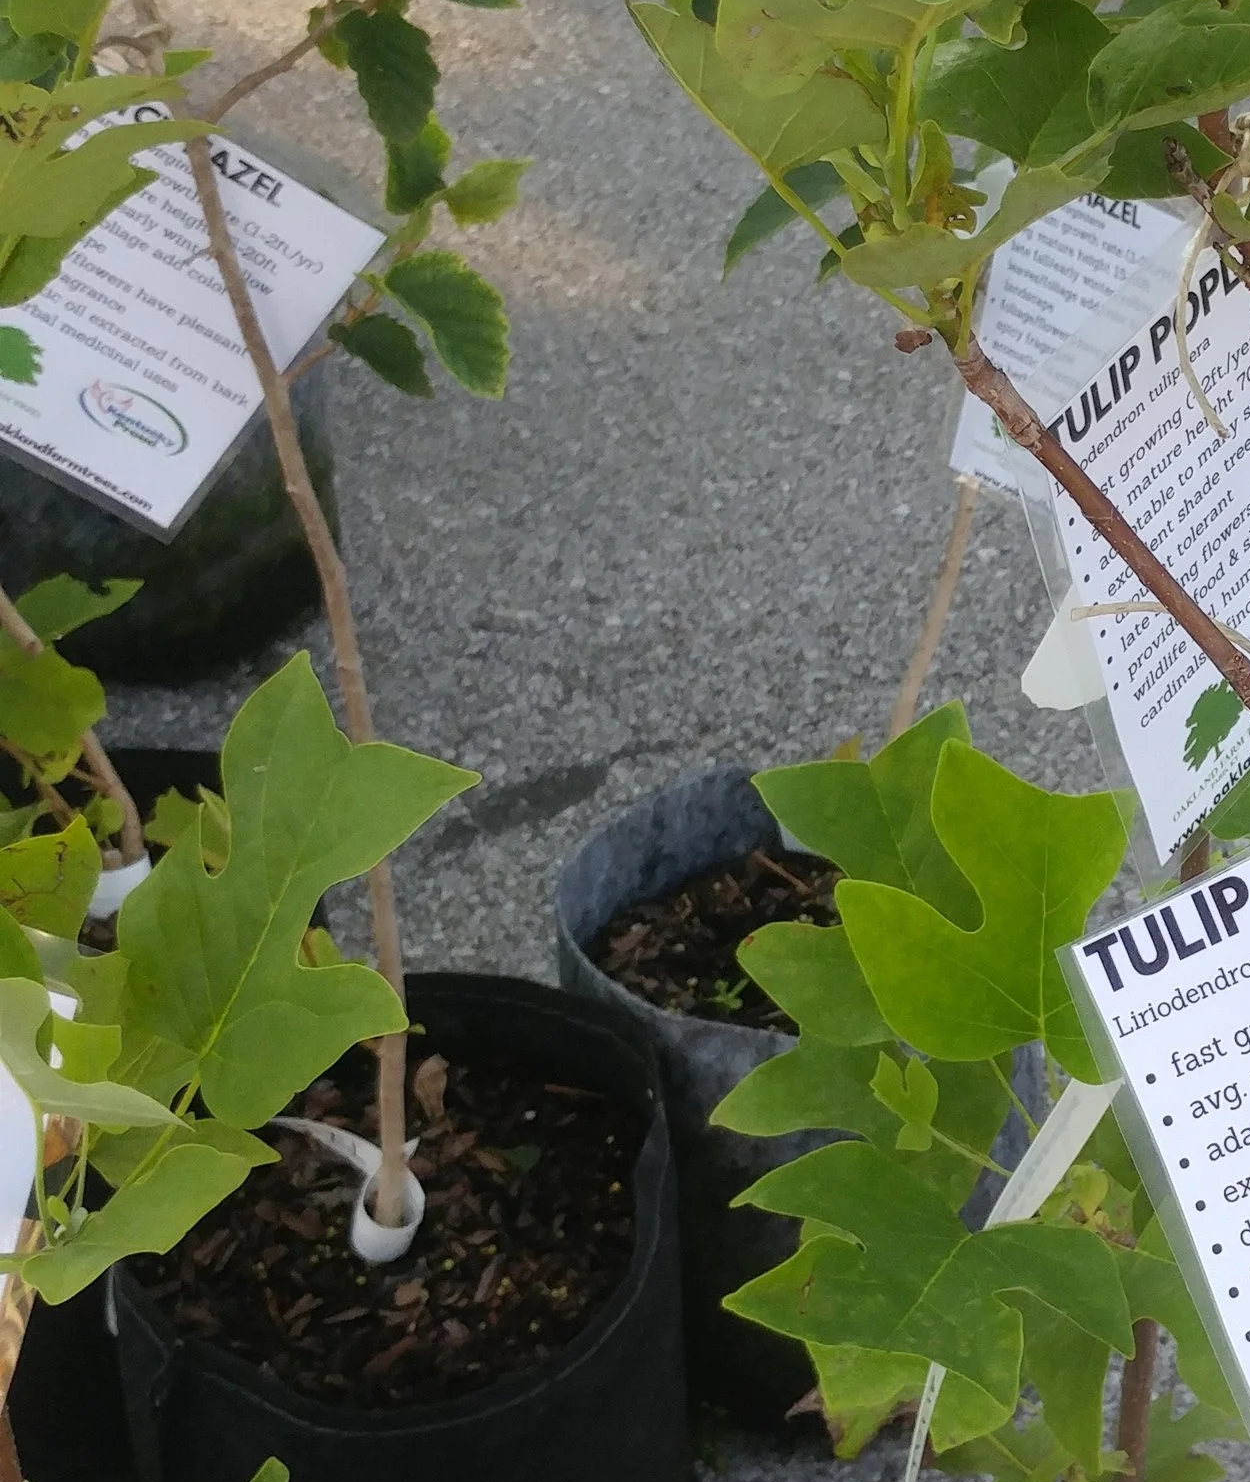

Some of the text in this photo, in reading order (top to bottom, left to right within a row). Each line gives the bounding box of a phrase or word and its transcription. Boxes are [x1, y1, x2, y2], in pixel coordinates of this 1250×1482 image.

[210, 150, 285, 208] AZEL
[136, 288, 176, 318] have
[60, 323, 141, 371] medicinal
[88, 314, 168, 361] extracted
[168, 356, 208, 385] from
[1119, 407, 1182, 483] growing
[1127, 444, 1182, 506] mature
[1178, 466, 1194, 486] to
[1178, 472, 1220, 523] shade
[1177, 490, 1234, 556] tolerant
[1193, 562, 1225, 607] food
[1229, 549, 1239, 567] &
[1120, 616, 1150, 652] late
[1133, 641, 1187, 701] wildlife
[1082, 876, 1249, 992] TULIP
[1171, 1038, 1228, 1077] fast
[1190, 1082, 1247, 1119] avg.
